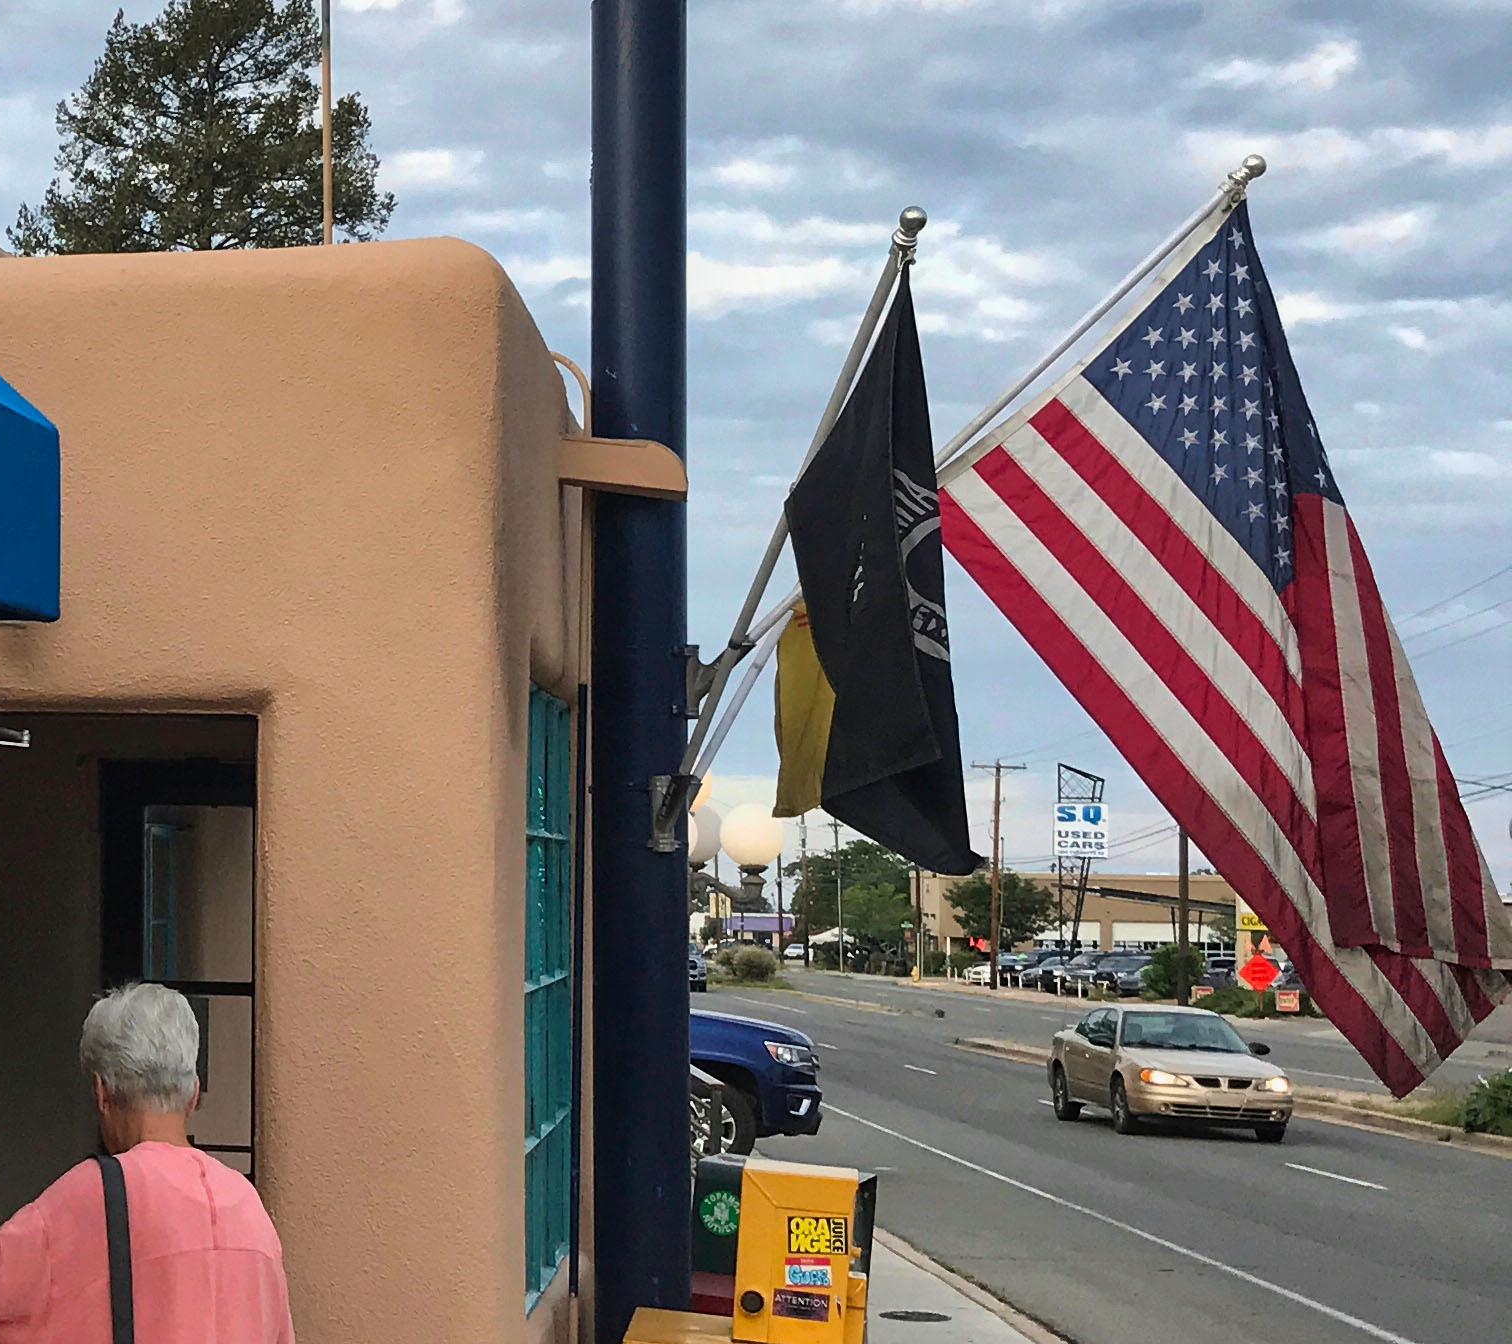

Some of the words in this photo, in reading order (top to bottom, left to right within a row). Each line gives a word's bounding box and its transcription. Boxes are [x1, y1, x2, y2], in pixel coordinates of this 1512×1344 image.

[1057, 830, 1105, 840] USED
[1057, 840, 1105, 850] CARS
[832, 1218, 844, 1254] JUICE
[774, 1294, 828, 1308] ATTENTION
